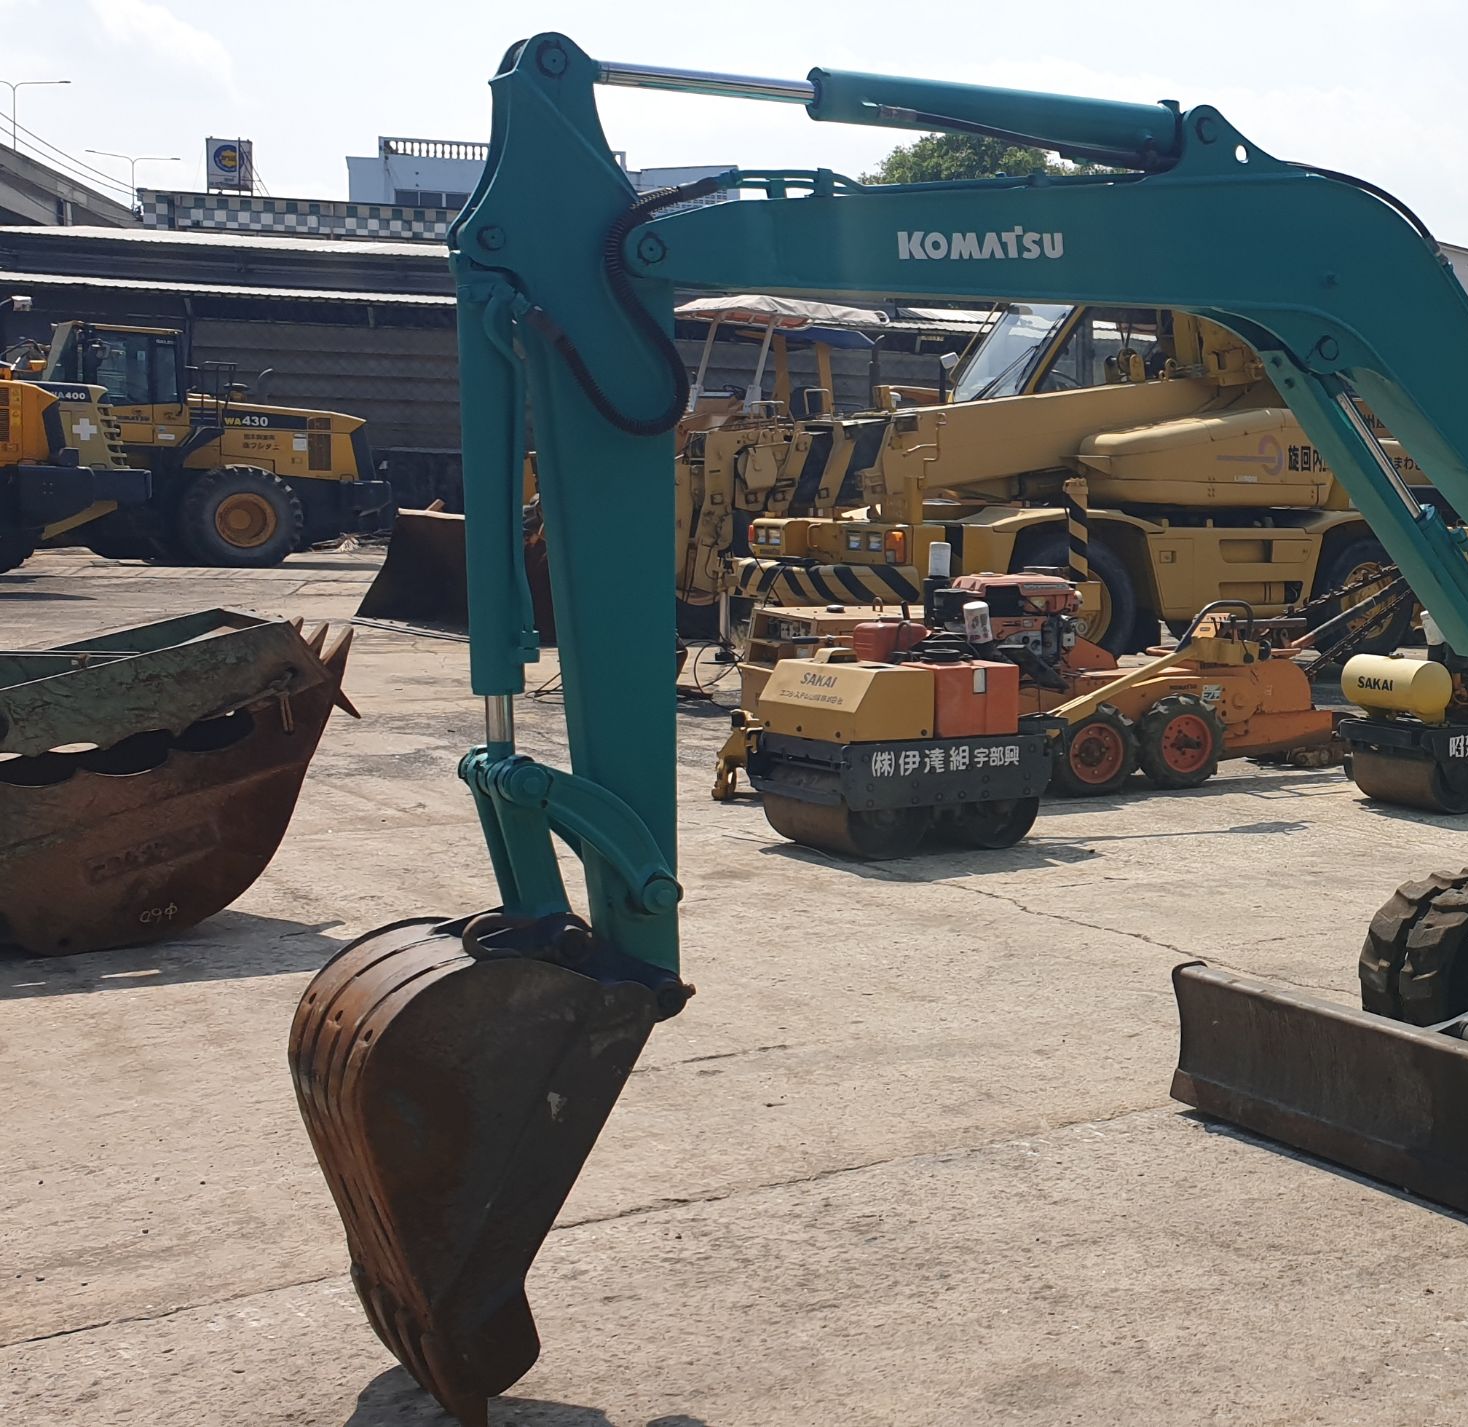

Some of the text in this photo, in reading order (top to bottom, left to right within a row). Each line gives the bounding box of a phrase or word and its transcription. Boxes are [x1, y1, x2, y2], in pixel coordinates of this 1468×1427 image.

[897, 225, 1064, 260] KOMATSU
[52, 391, 86, 400] A400
[224, 415, 269, 427] WA430
[800, 672, 838, 688] SAKAI
[1357, 675, 1393, 691] SAKAI
